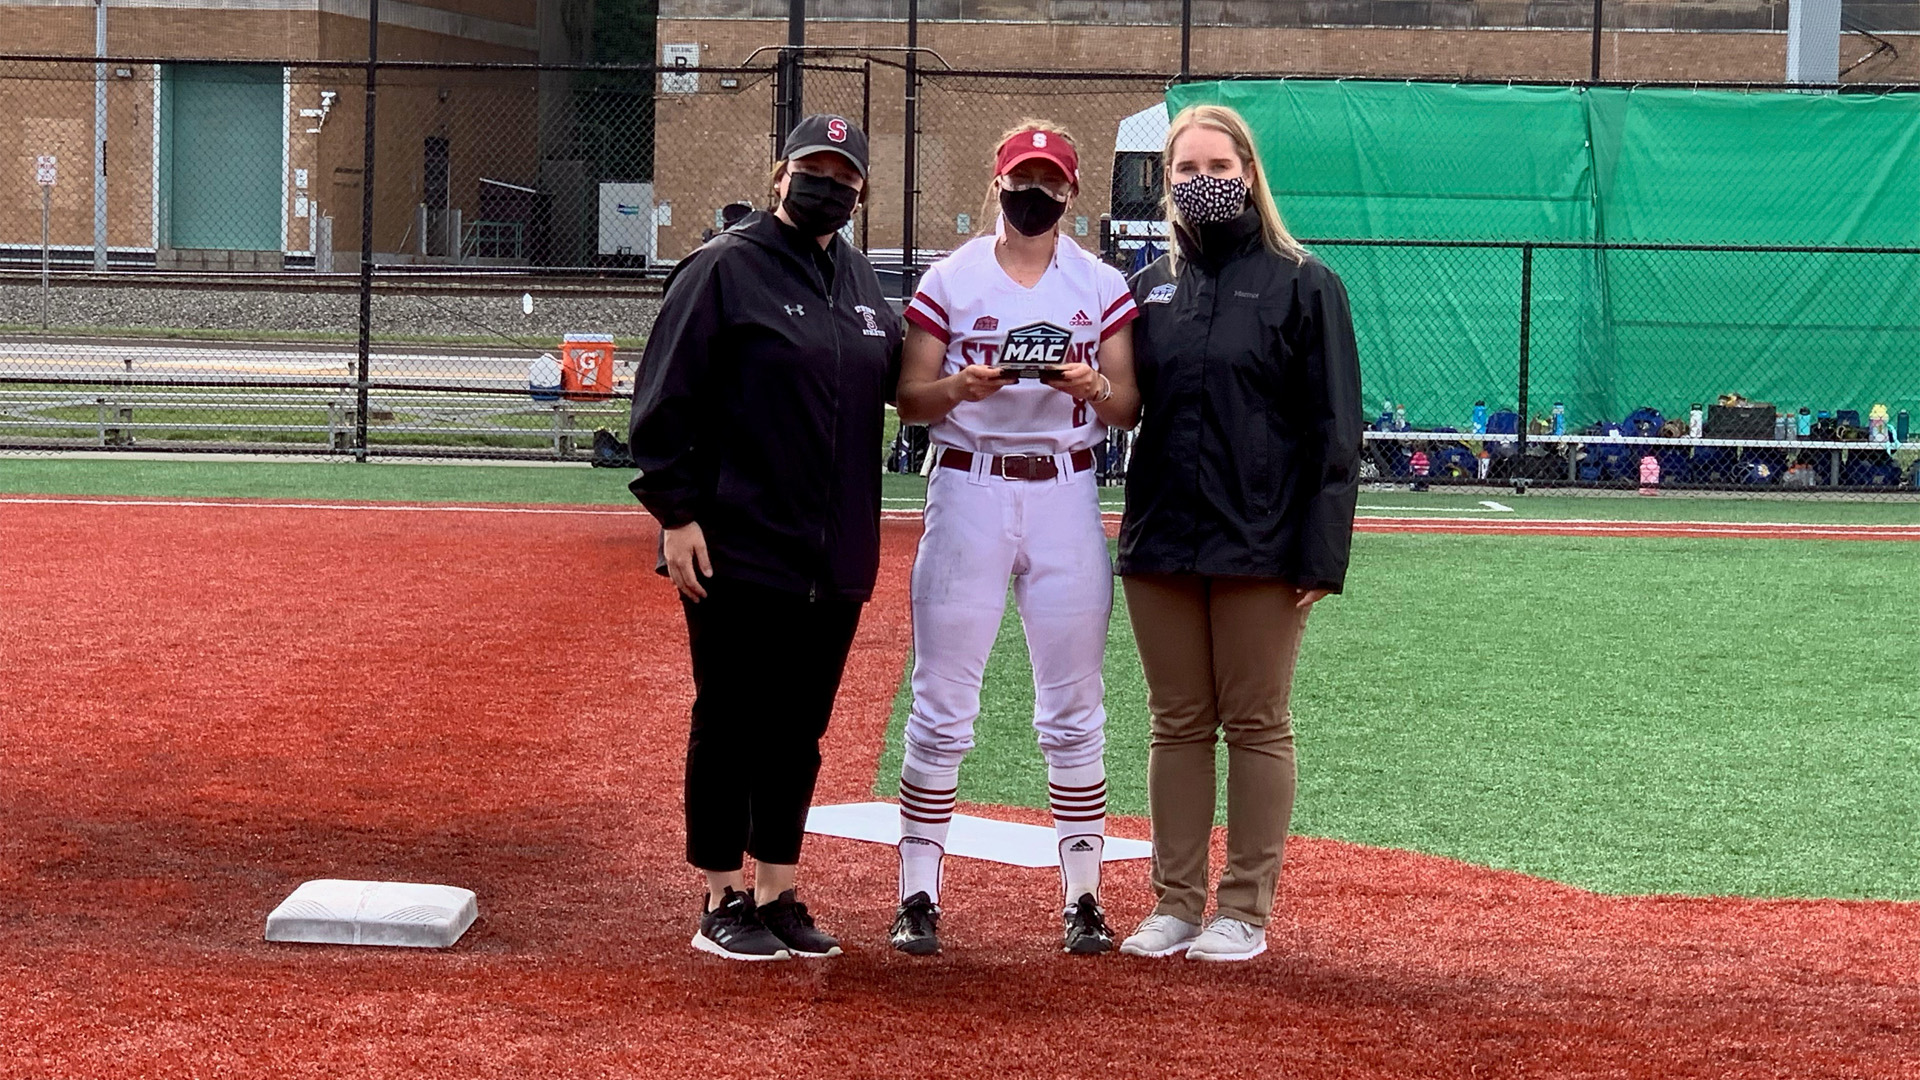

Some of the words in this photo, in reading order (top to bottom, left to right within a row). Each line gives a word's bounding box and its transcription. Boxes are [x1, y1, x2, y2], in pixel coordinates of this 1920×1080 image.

[827, 118, 847, 142] S
[1032, 132, 1047, 149] S
[1148, 292, 1173, 301] MAC
[580, 352, 598, 369] G
[1003, 343, 1065, 362] MAC
